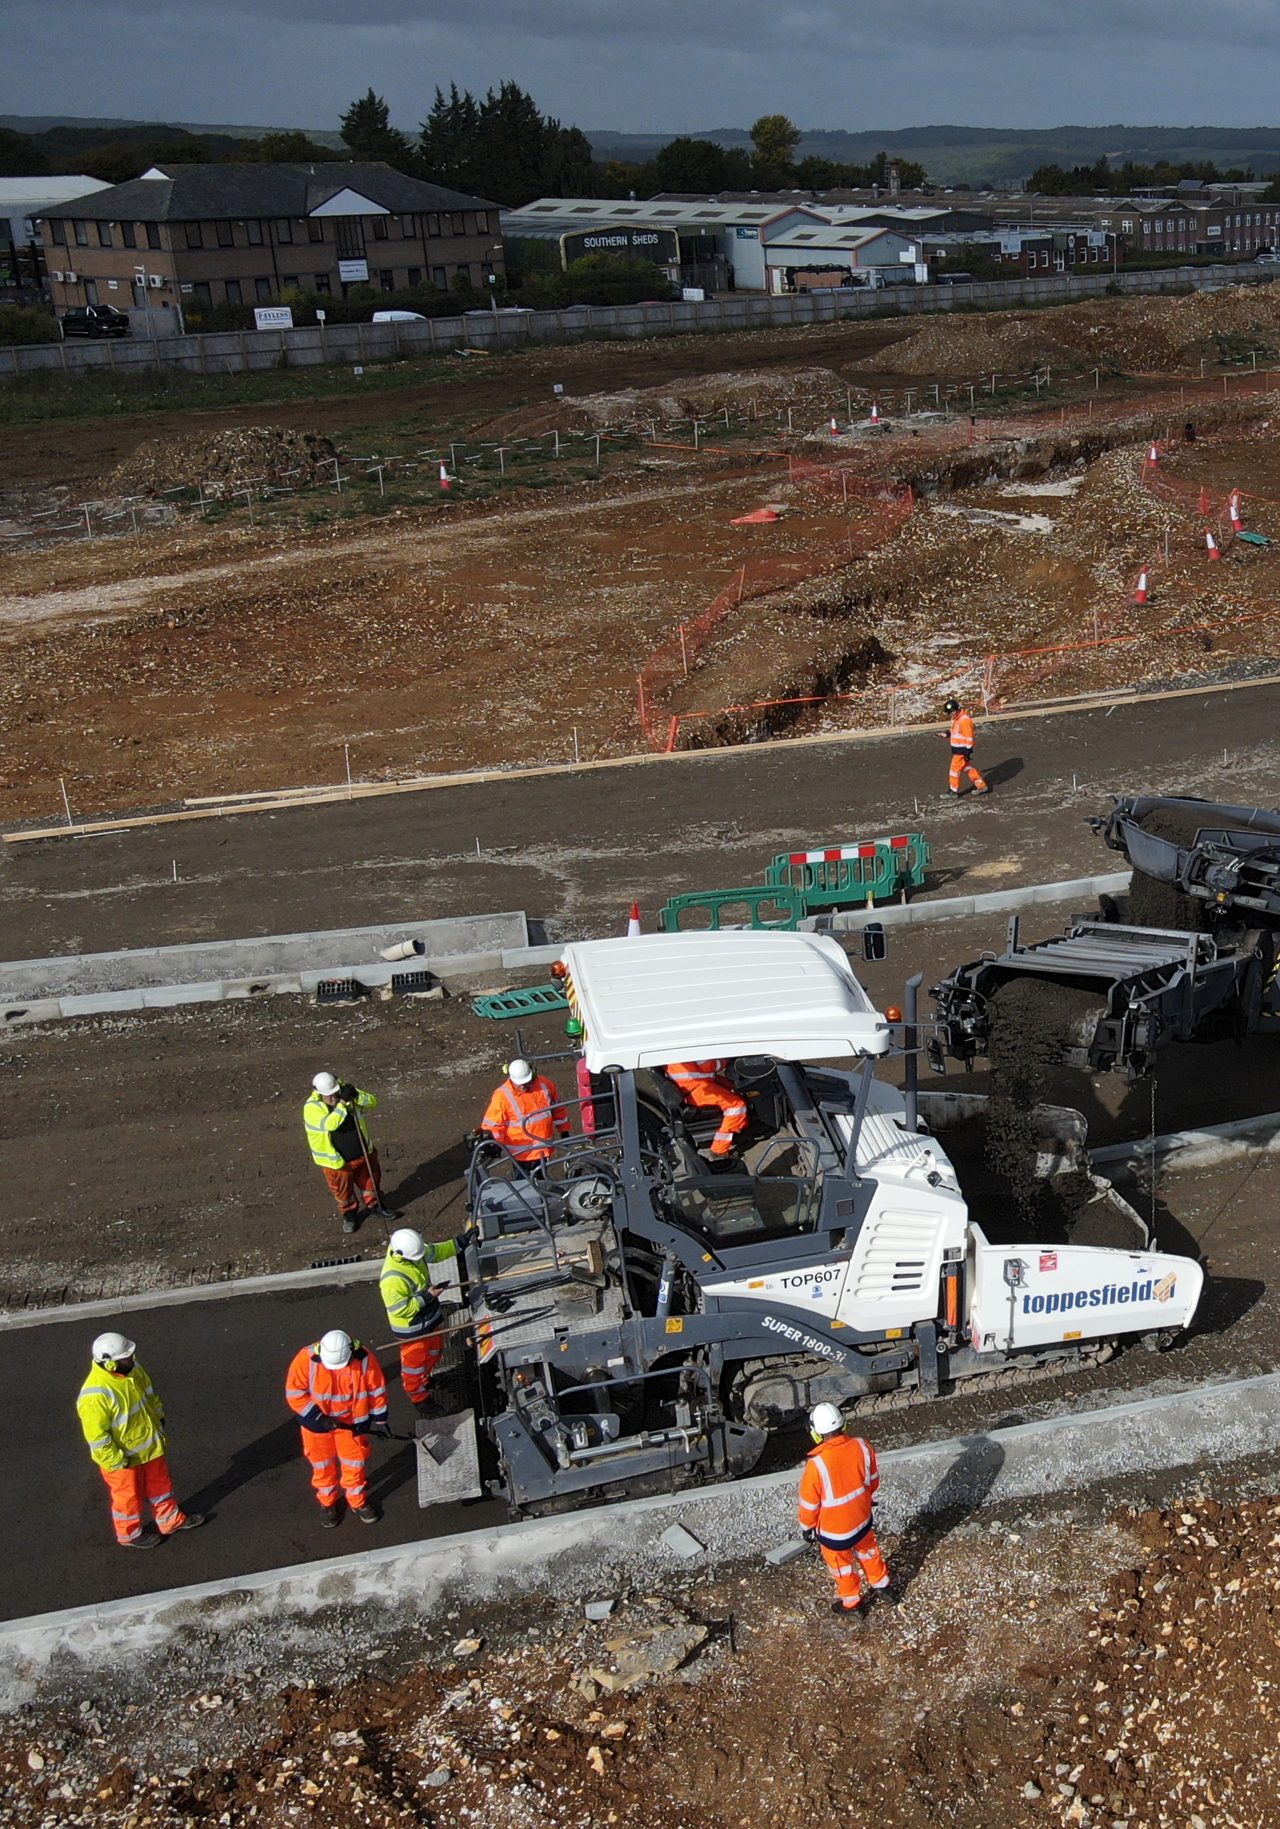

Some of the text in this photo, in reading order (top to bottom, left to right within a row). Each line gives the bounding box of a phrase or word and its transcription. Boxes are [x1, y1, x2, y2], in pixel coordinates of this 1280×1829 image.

[584, 234, 659, 248] SOUTHERN SHEDS
[781, 1269, 841, 1289] TOP607
[1023, 1278, 1150, 1315] toppesfield
[761, 1316, 847, 1367] SUPER 1800-3i
